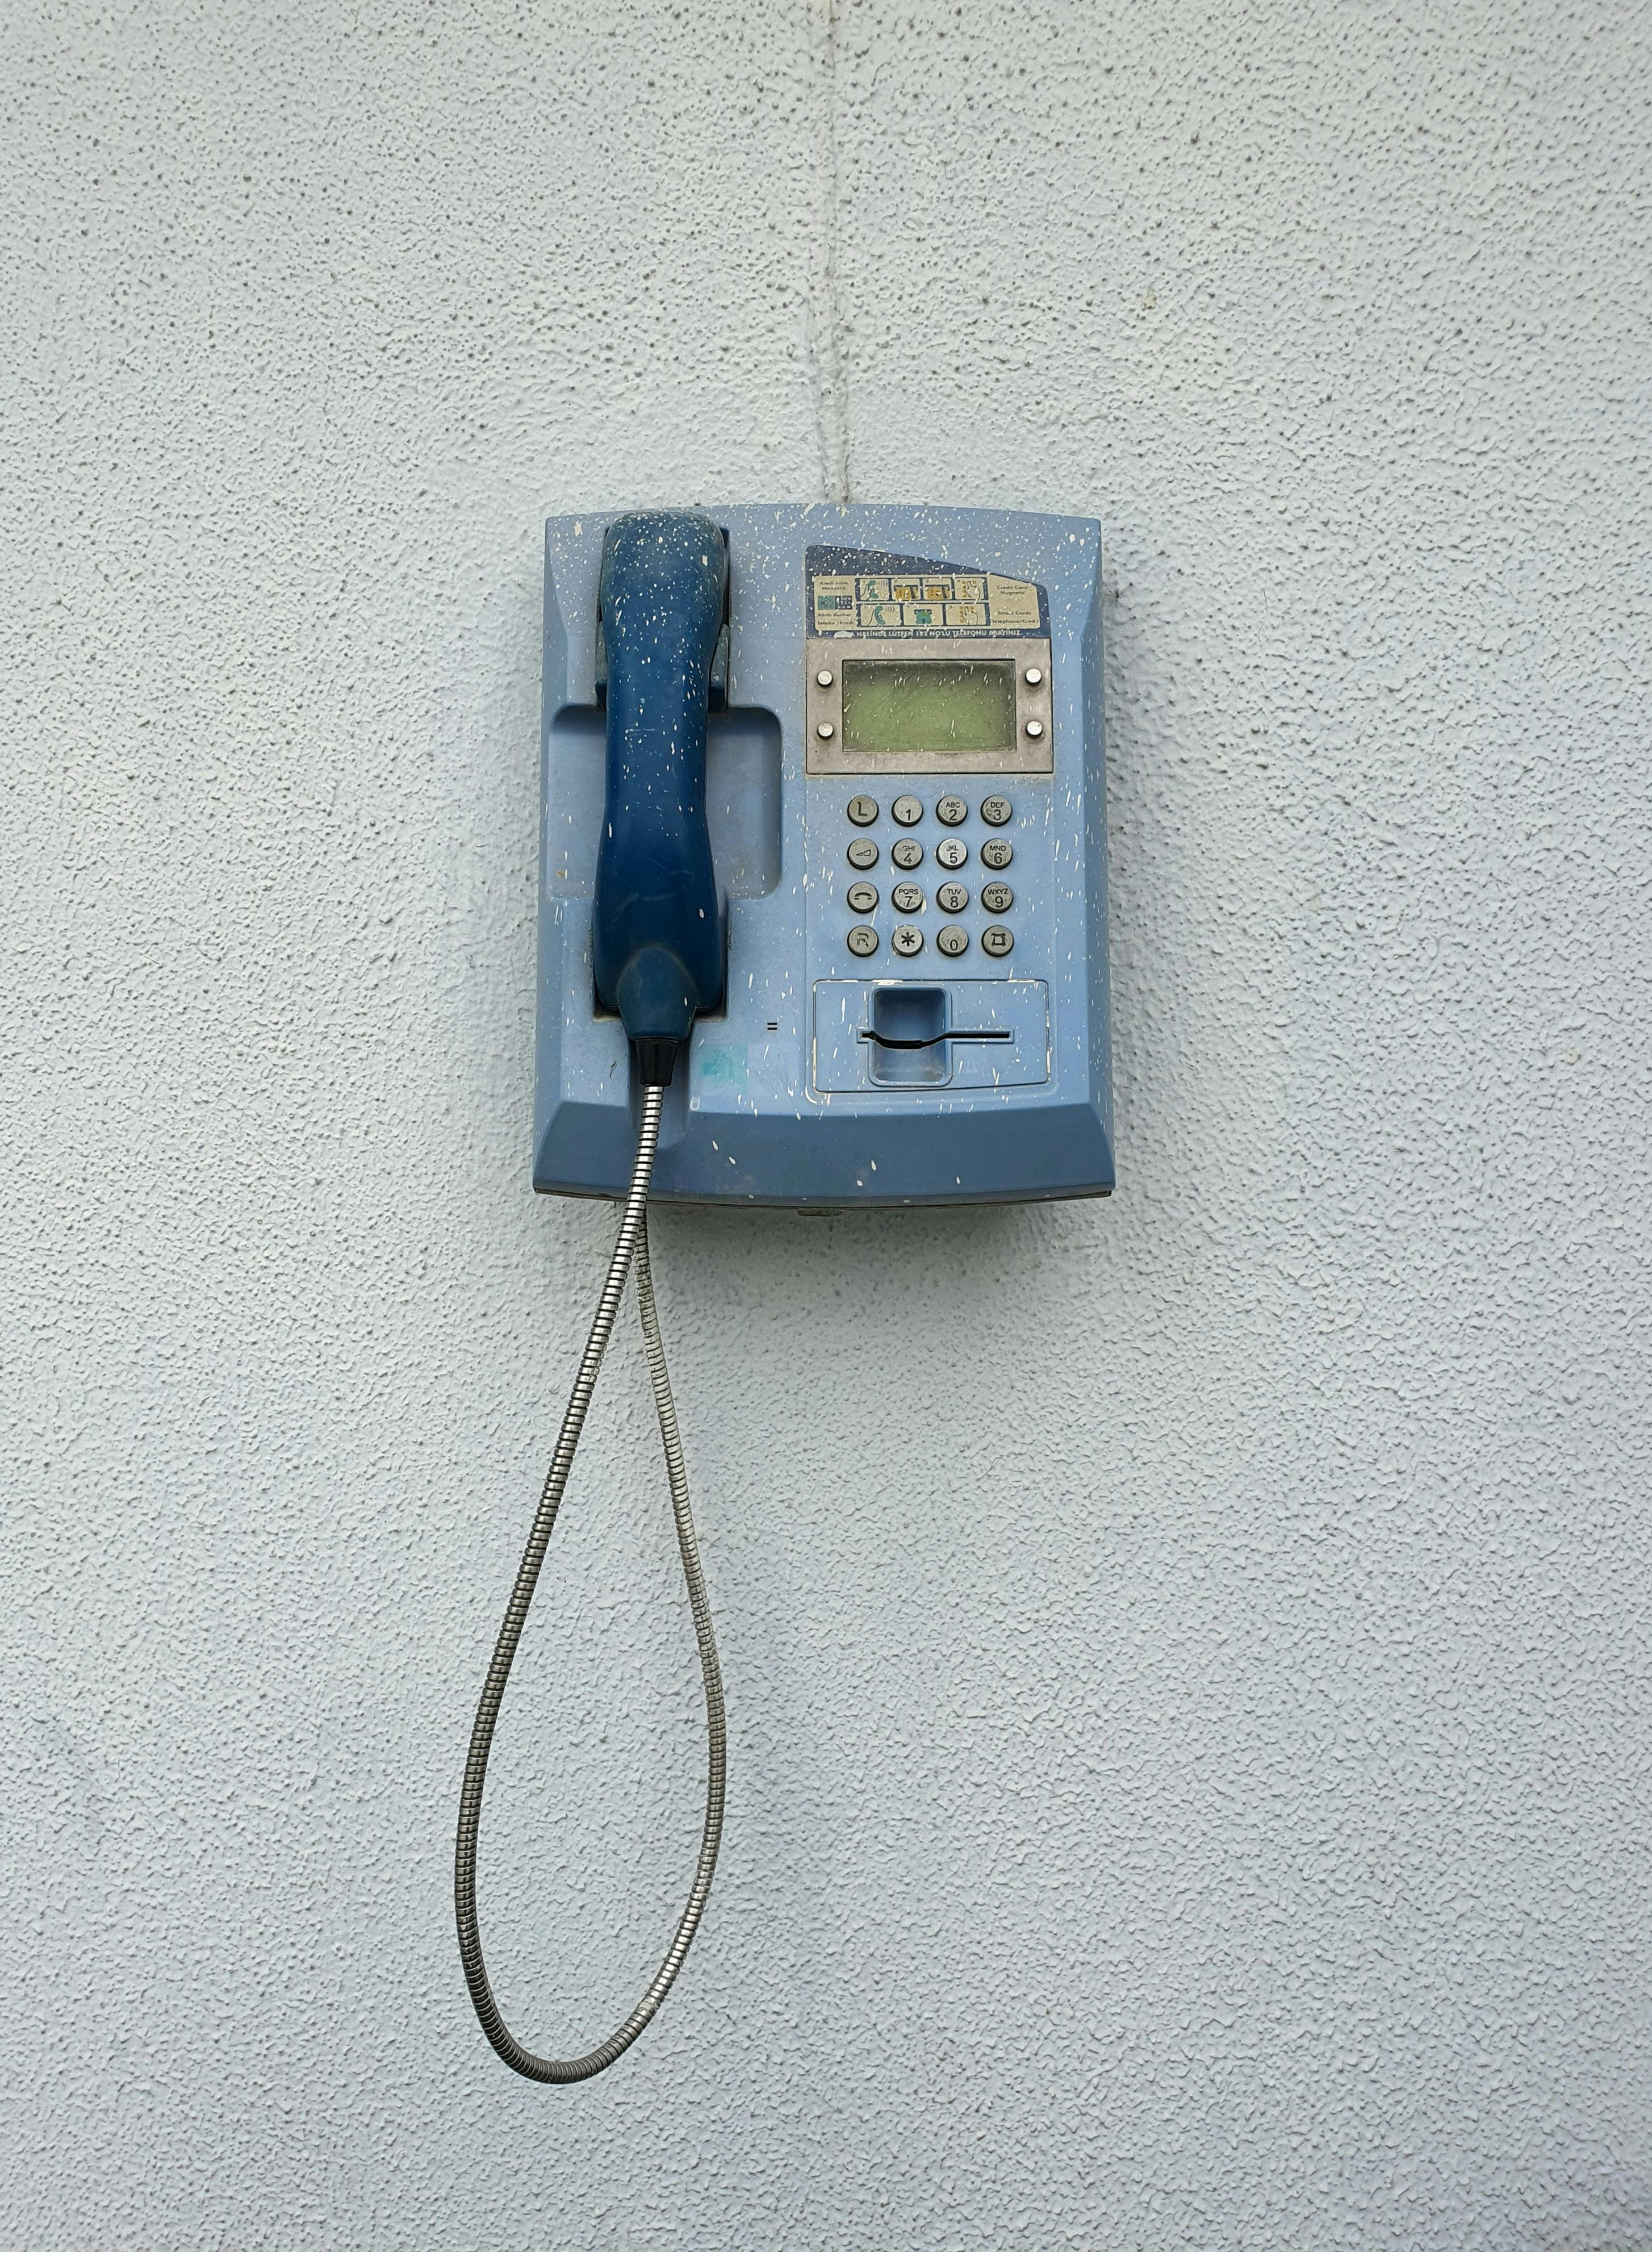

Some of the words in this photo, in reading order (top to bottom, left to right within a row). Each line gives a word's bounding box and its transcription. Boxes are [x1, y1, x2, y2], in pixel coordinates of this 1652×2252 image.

[906, 809, 911, 821] 1
[949, 809, 957, 821] 2
[993, 809, 1001, 821] 3
[904, 853, 912, 864] 4
[950, 853, 957, 864] 5
[994, 853, 1002, 864] 6
[905, 896, 913, 908] 7
[950, 896, 959, 908] 8
[995, 896, 1003, 908] 9
[857, 933, 869, 947] R
[950, 939, 958, 951] 0
